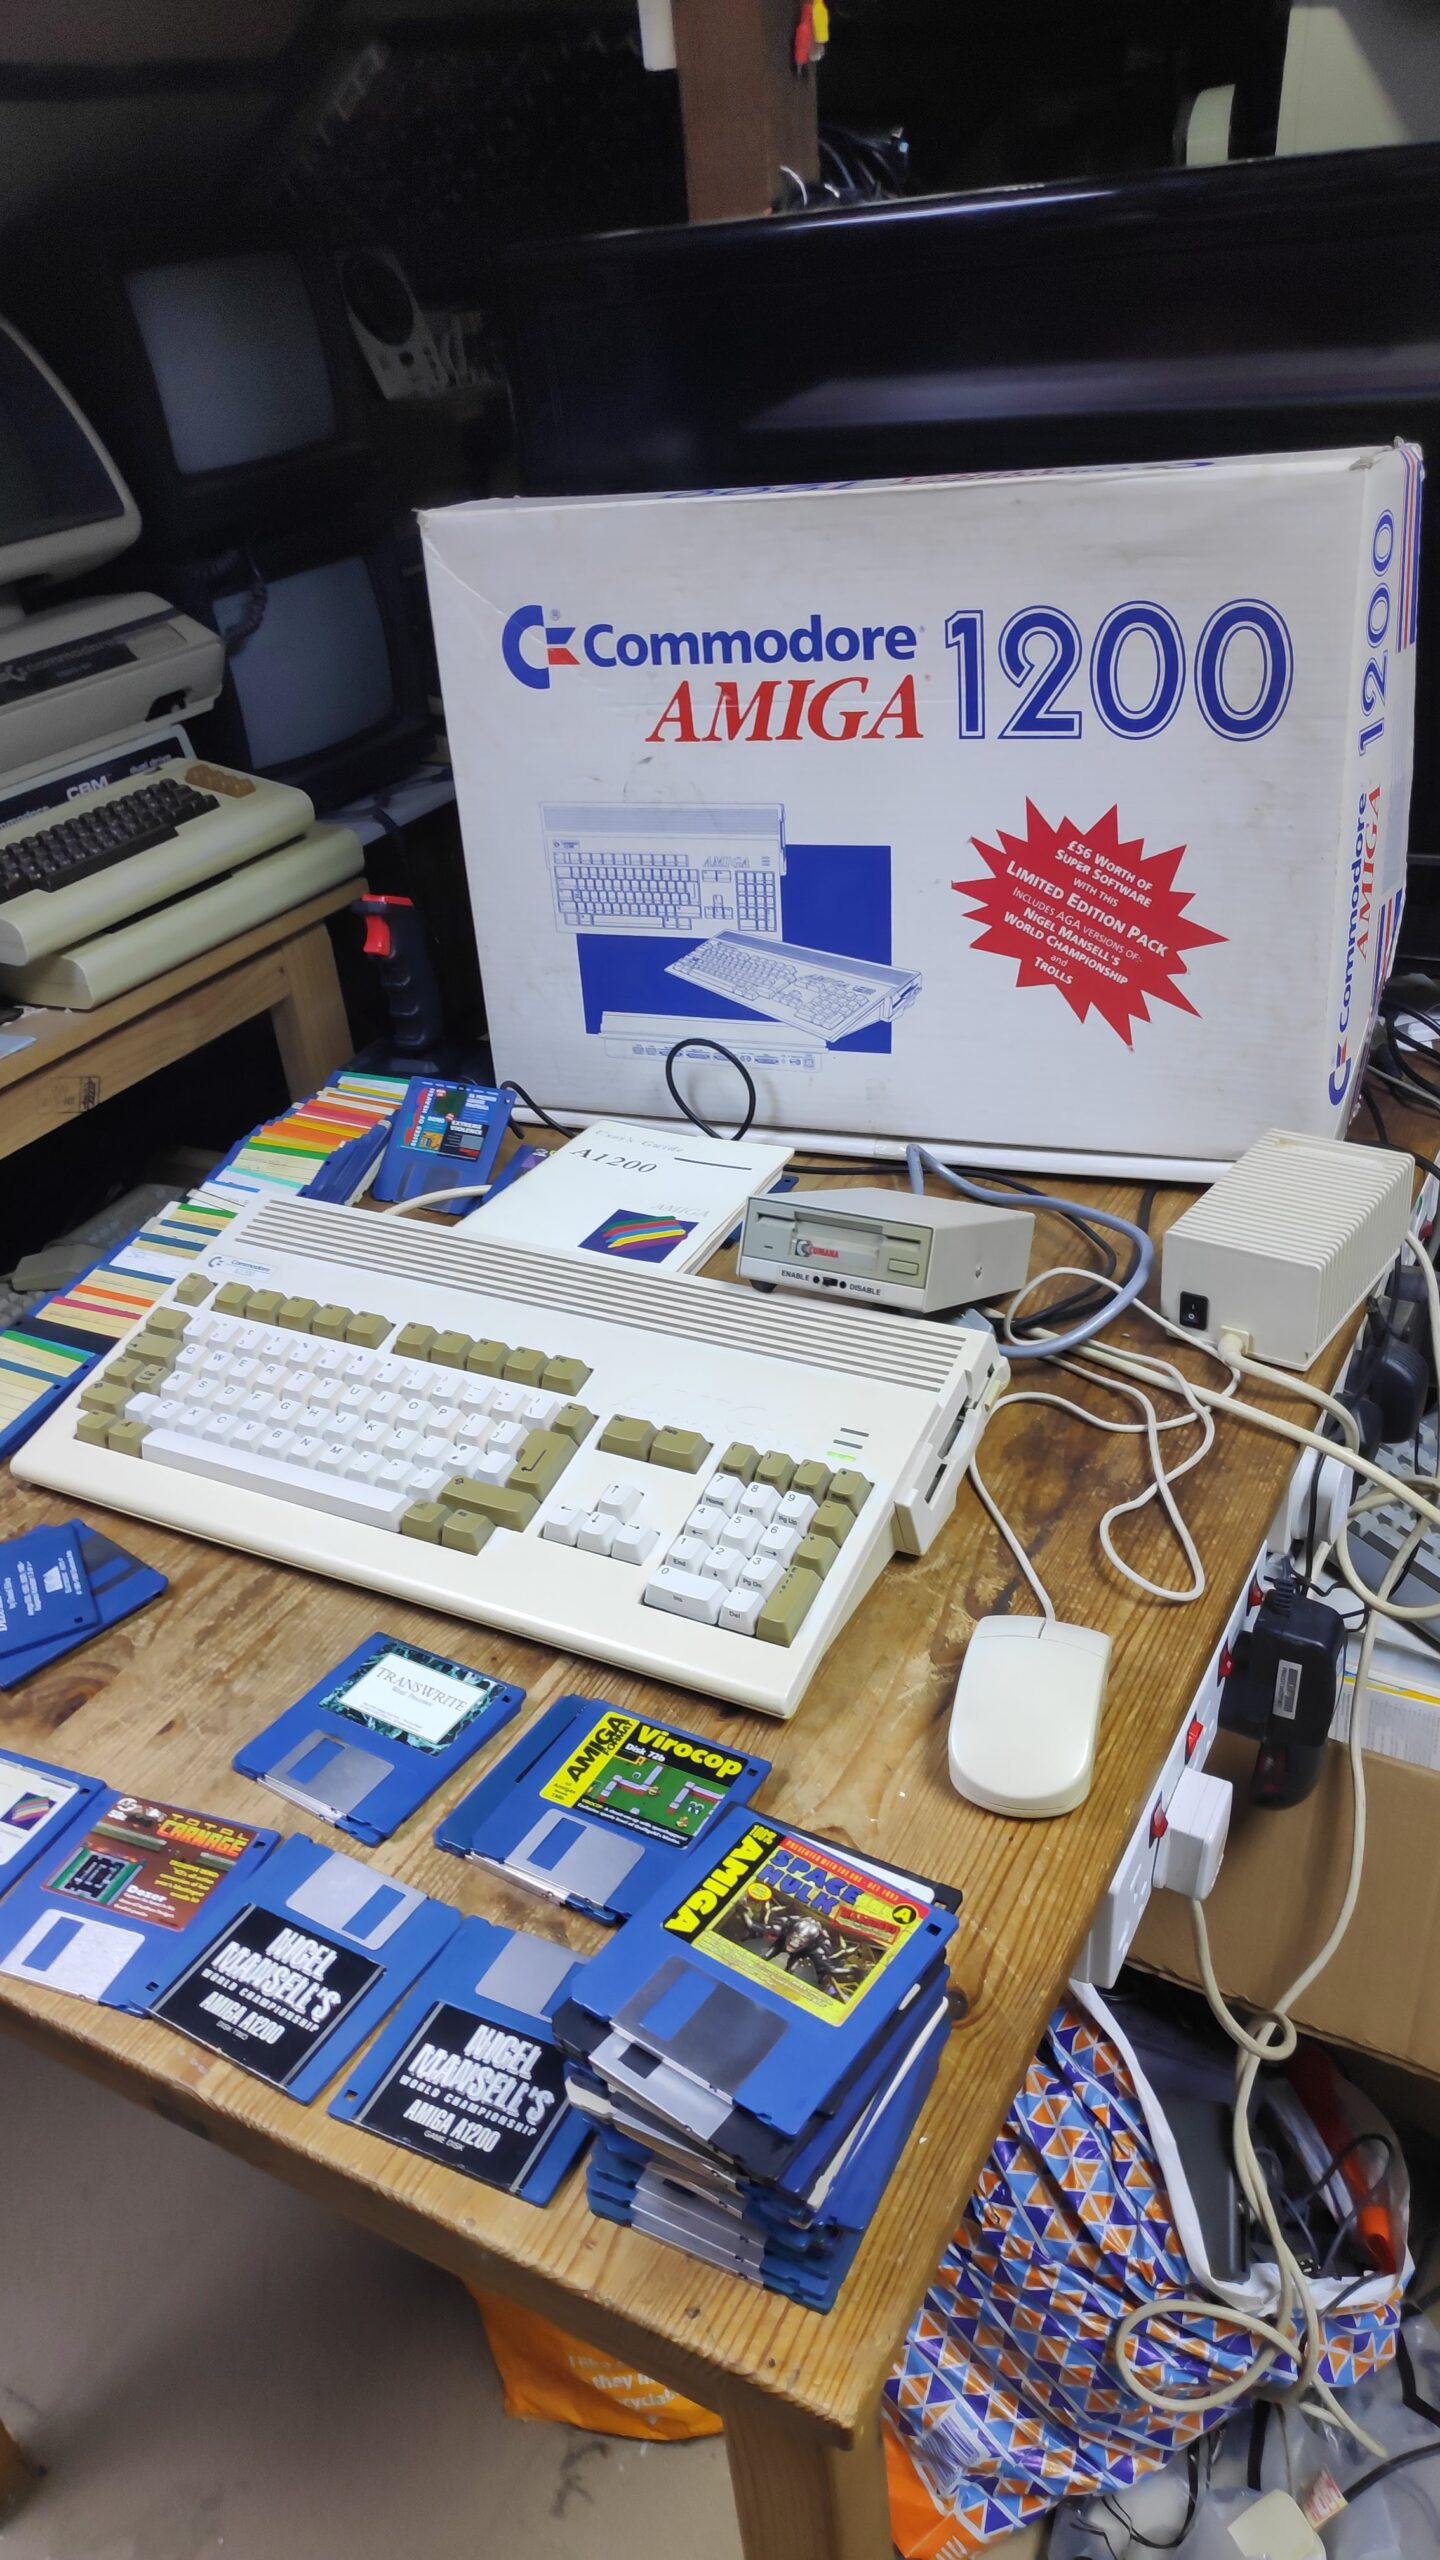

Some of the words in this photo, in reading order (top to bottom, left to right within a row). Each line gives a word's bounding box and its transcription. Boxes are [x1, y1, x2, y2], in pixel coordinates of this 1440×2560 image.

[584, 614, 917, 668] Commodore
[1358, 508, 1394, 756] 1200
[945, 598, 1294, 742] 1200
[645, 674, 924, 743] AMIGA
[66, 775, 109, 800] CBM
[1054, 849, 1090, 875] SUPER
[1091, 868, 1152, 908] SOFTWARE
[1067, 840, 1091, 860] £56
[1094, 853, 1135, 884] WORTH
[1136, 877, 1154, 892] OF
[1073, 877, 1098, 896] WITH
[1099, 890, 1119, 907] THIS
[1357, 784, 1381, 960] AMIGA
[1006, 860, 1064, 899] LIMITED
[1066, 892, 1126, 933] EDITION
[1126, 925, 1168, 957] PACK
[1012, 886, 1055, 916] INCLUDES
[1056, 911, 1080, 930] AGA
[1083, 925, 1125, 953] VERSIONS
[1339, 792, 1367, 1033] Commodore
[1003, 911, 1044, 940] WORLD
[1046, 936, 1128, 985] CHAMPIONSHIP
[1023, 907, 1056, 932] NIGEL
[1058, 926, 1121, 966] MANSELL'S
[1050, 954, 1068, 967] and
[1034, 957, 1073, 985] TROLLS
[570, 1147, 658, 1173] A1200
[642, 1139, 684, 1153] Guide
[781, 1269, 810, 1282] ENABLE
[849, 1283, 881, 1296] DISABLE
[673, 1559, 686, 1567] End
[729, 1611, 741, 1619] Del
[376, 1666, 468, 1712] TRANSWRITE
[564, 1716, 628, 1782] AMIGA
[624, 1742, 646, 1757] Disk
[646, 1750, 666, 1762] 72b
[636, 1728, 743, 1779] Virocop
[157, 1819, 248, 1858] CARNAGE
[172, 1813, 249, 1842] TOTAL
[749, 1824, 777, 1845] 100%
[664, 1835, 763, 1933] AMIGA
[756, 1864, 840, 1915] HULK
[769, 1849, 865, 1906] SPACE
[265, 1927, 338, 1981] NIGEL
[201, 1968, 239, 1991] WORLD
[239, 1987, 320, 2032] CHAMPIONSHIP
[211, 1941, 342, 2024] MANSELL'S
[199, 1991, 248, 2026] AMIGA
[238, 2011, 286, 2045] A1200
[464, 2024, 542, 2081] NIGEL
[400, 2074, 440, 2098] WORLD
[444, 2094, 537, 2136] CHAMPIONSHIP
[407, 2043, 555, 2126] MANSELL'S
[403, 2099, 456, 2135] AMIGA
[449, 2118, 501, 2153] A1200
[424, 2130, 445, 2145] GAME
[445, 2136, 465, 2152] DISK
[592, 2374, 633, 2390] they
